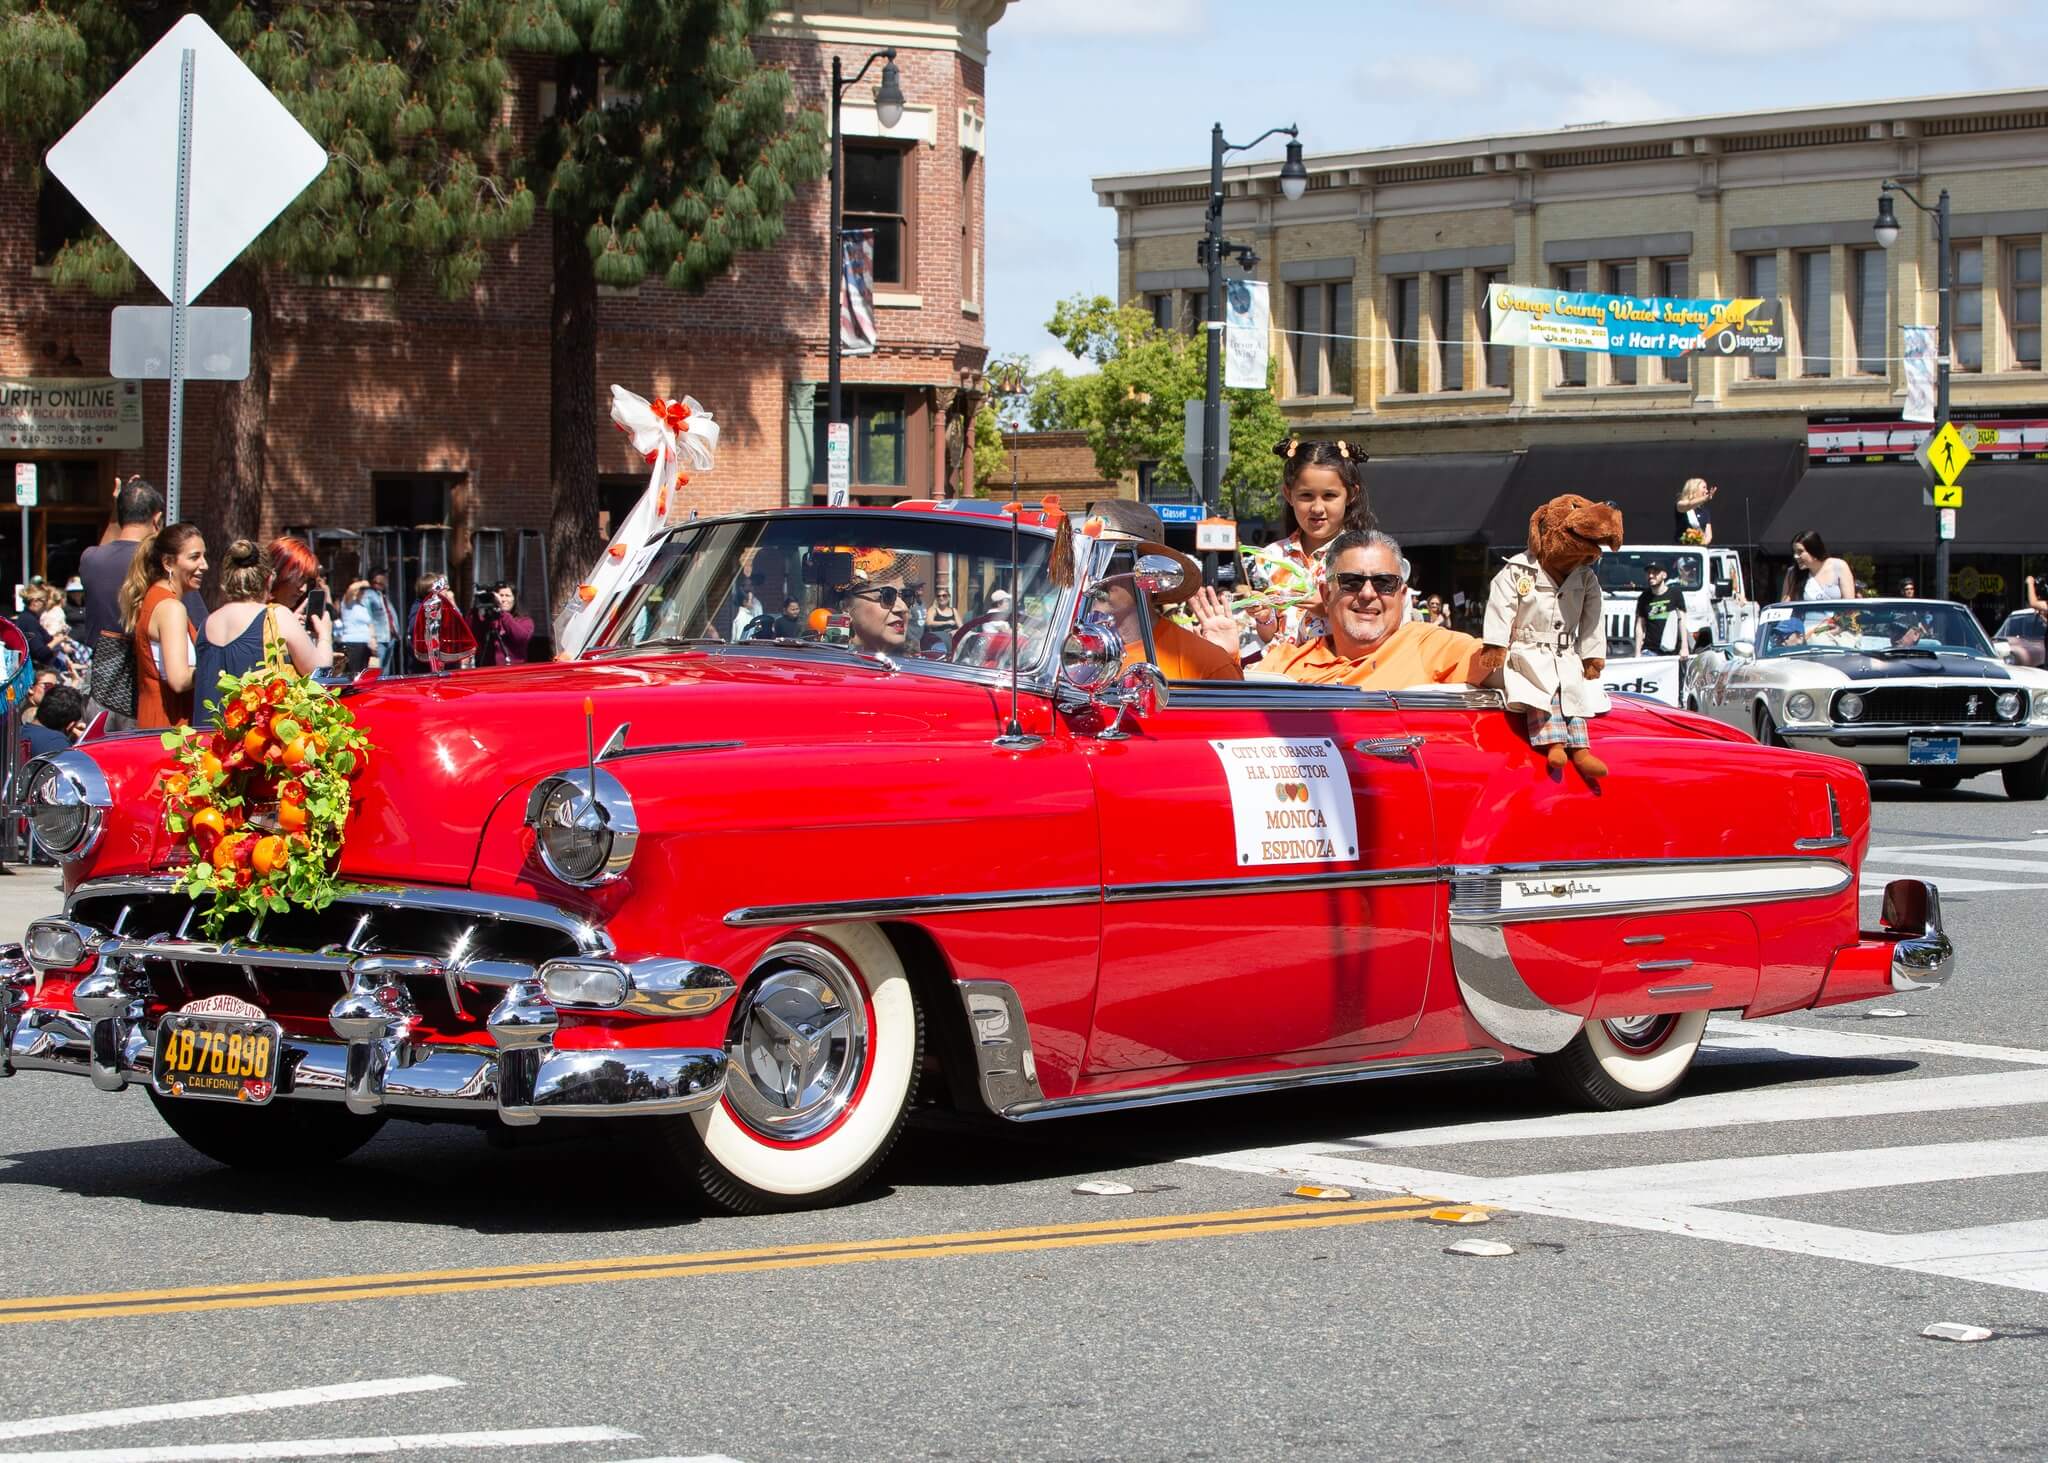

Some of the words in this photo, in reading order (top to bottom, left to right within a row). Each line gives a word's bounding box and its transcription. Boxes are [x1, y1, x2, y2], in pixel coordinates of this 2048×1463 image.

[1497, 292, 1551, 320] Orange
[1555, 295, 1605, 326] County
[1608, 300, 1657, 321] Water
[1663, 303, 1708, 331] Safety
[1710, 303, 1745, 331] Day
[1610, 333, 1625, 346] at
[1629, 331, 1666, 349] Hart
[1668, 331, 1706, 349] Park
[1735, 334, 1765, 350] Jasper
[1766, 334, 1784, 349] Ray
[0, 390, 42, 407] URTH
[48, 390, 114, 407] ONLINE
[78, 408, 118, 418] DELIVERY
[1978, 431, 1996, 442] KUA
[1162, 508, 1187, 518] Glassell
[1232, 747, 1261, 759] CITY
[1263, 746, 1277, 759] OF
[1280, 745, 1328, 759] ORANGE
[1245, 766, 1271, 779] H.R.
[1272, 765, 1329, 779] DIRECTOR
[1265, 809, 1327, 829] MONICA
[1262, 839, 1336, 860] ESPINOZA
[185, 999, 213, 1015] DRIVE
[212, 996, 238, 1013] SAFELY
[244, 1003, 262, 1018] LIVE
[165, 1029, 269, 1079] 4B76898
[166, 1075, 174, 1085] 19
[189, 1076, 239, 1090] CALIFORNIA
[253, 1085, 266, 1096] 54
